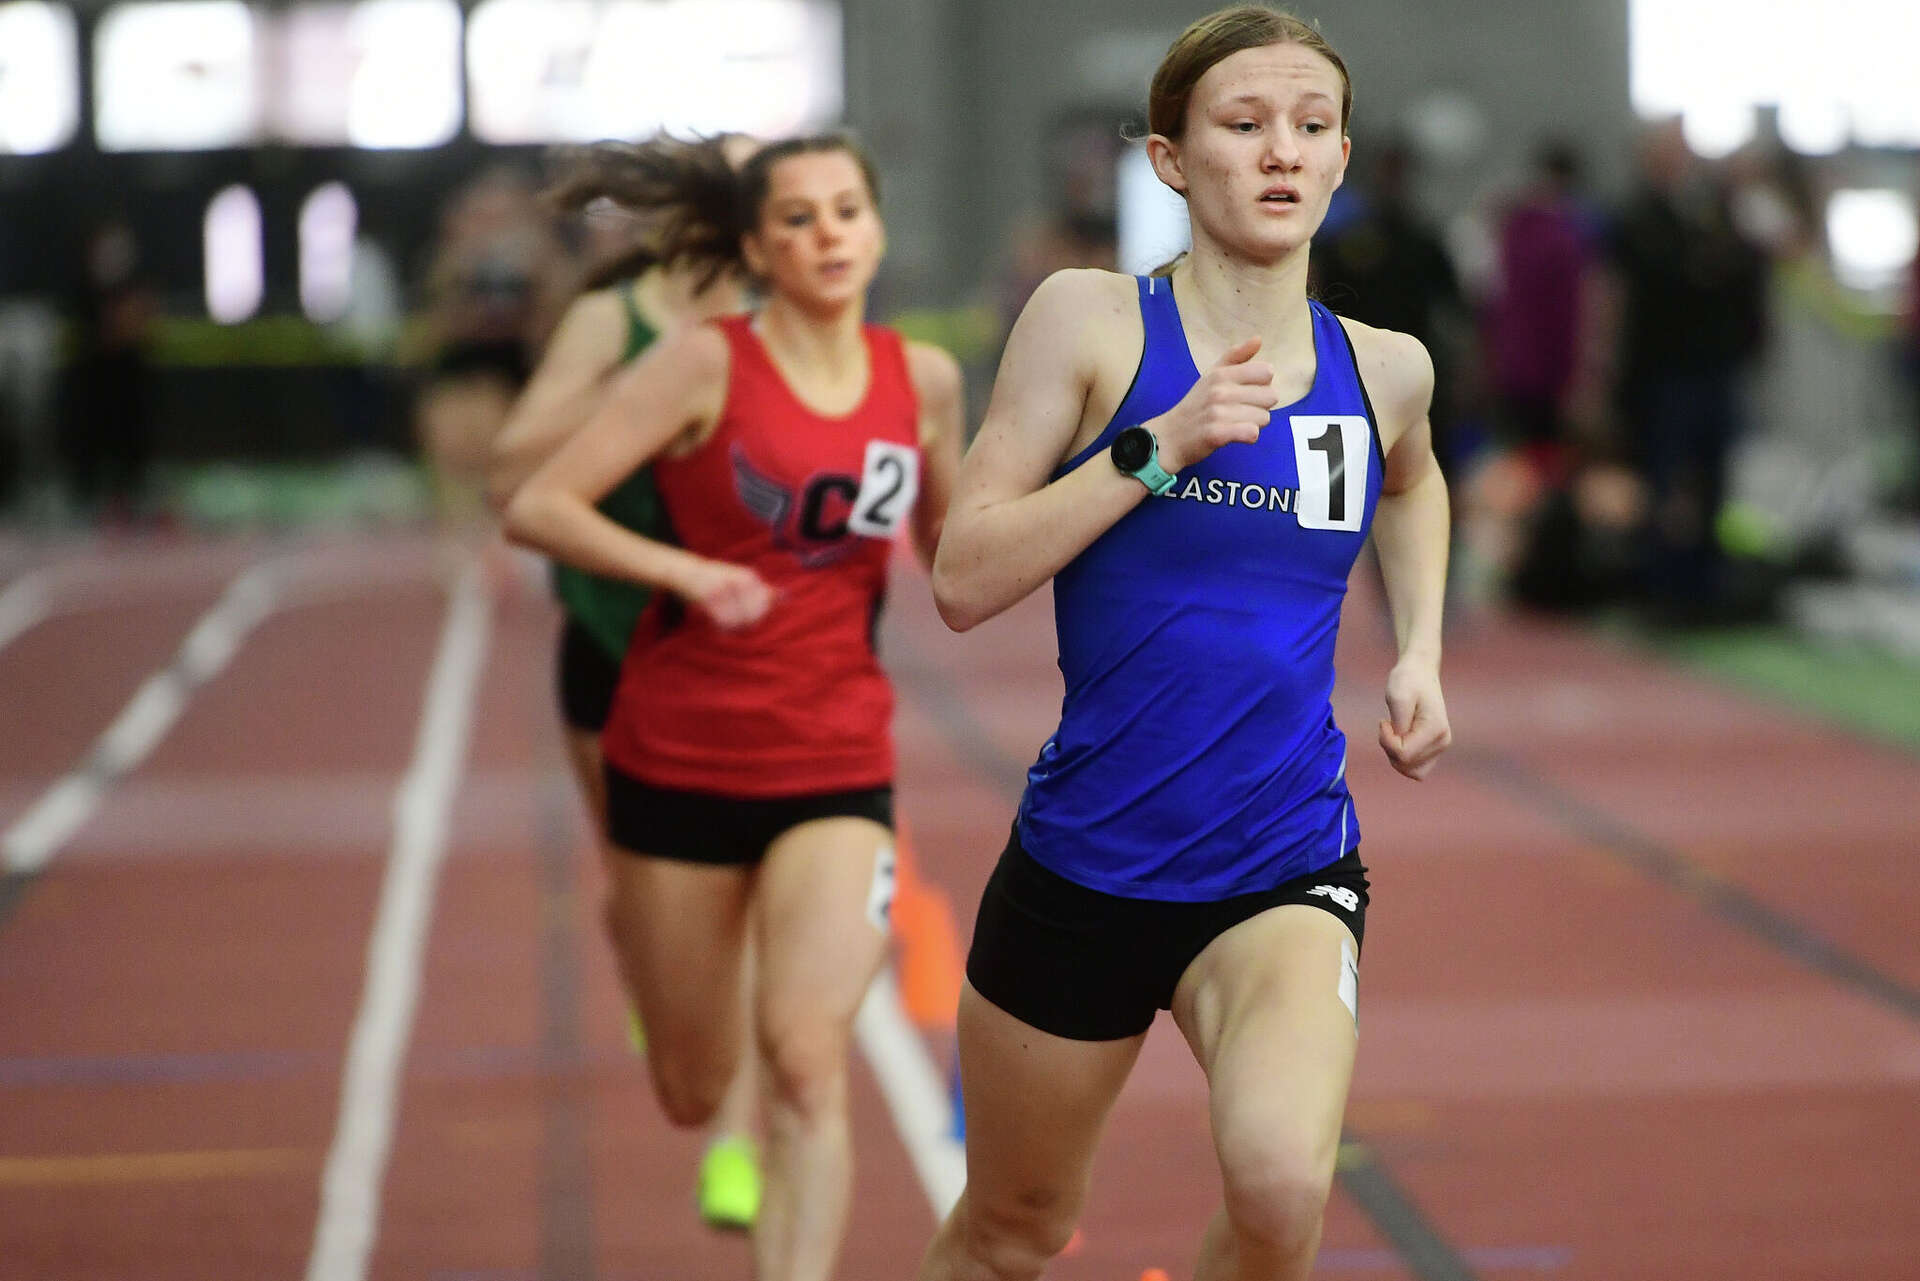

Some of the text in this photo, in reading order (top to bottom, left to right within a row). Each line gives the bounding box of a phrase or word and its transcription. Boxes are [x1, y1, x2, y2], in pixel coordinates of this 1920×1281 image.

[801, 473, 859, 541] C
[863, 454, 904, 527] 2
[1164, 476, 1301, 514] LASTON
[1307, 423, 1346, 522] 1
